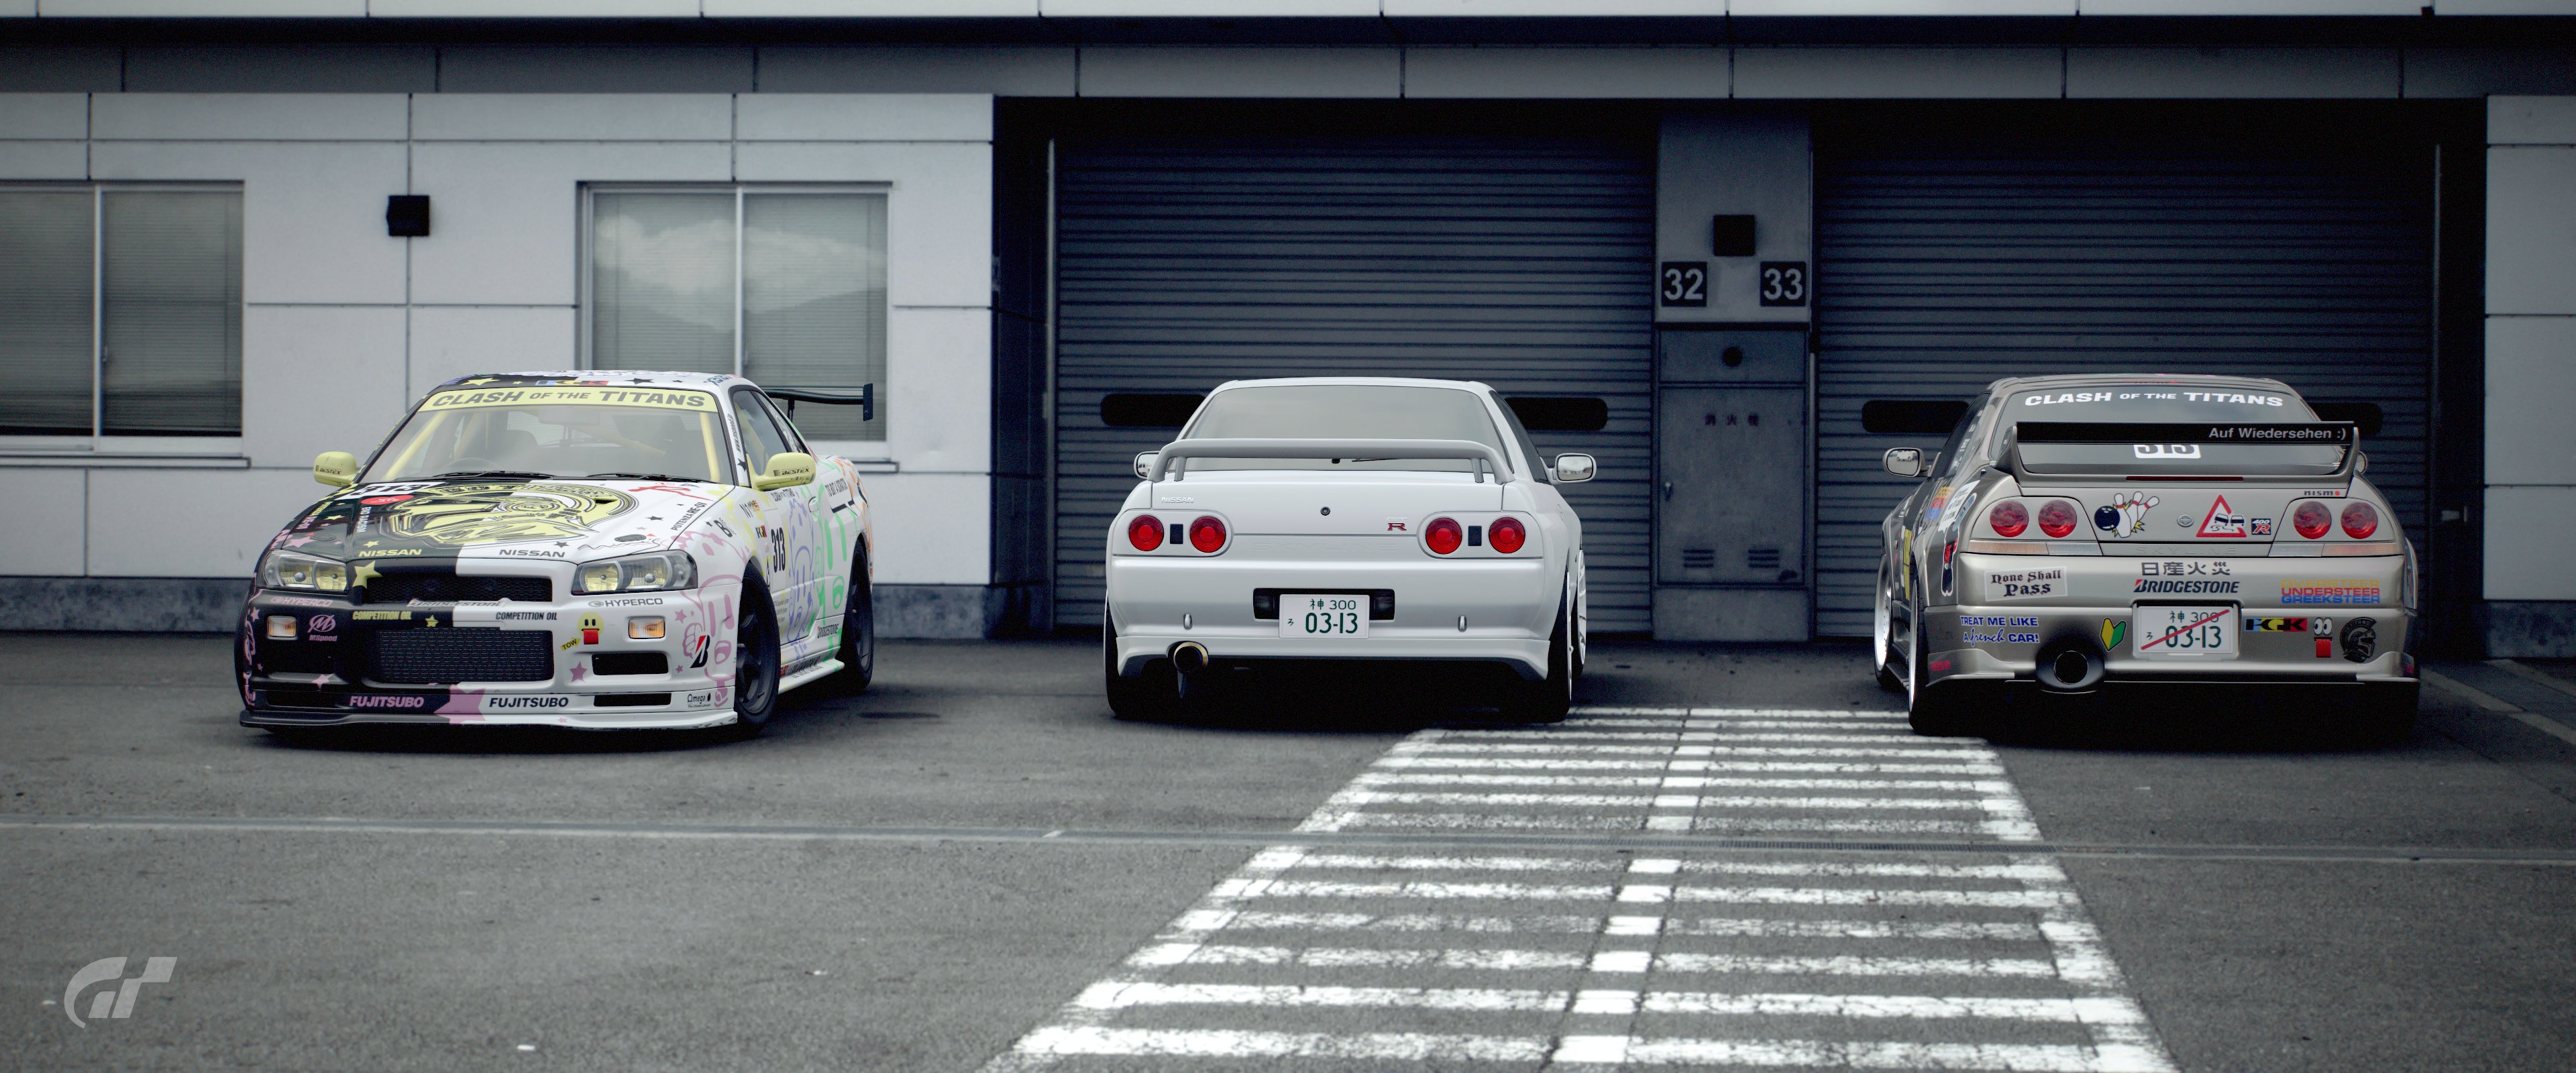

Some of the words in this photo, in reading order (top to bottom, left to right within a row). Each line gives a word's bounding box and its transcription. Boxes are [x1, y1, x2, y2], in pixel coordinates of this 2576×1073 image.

[1664, 268, 1703, 300] 32
[1763, 268, 1803, 300] 33
[433, 391, 524, 406] CLASH
[599, 391, 705, 407] TITANS
[2025, 392, 2112, 406] CLASH
[2183, 392, 2283, 406] TITANS
[2209, 427, 2233, 438] Auf
[2239, 427, 2331, 438] Wiedersehen
[671, 512, 694, 530] POTENZA
[690, 502, 707, 518] RE-01
[1387, 522, 1407, 530] R
[2253, 524, 2270, 534] R
[499, 549, 565, 557] NISSAN
[771, 527, 786, 573] 313
[1251, 543, 1397, 551] SKYLINE
[2141, 562, 2231, 575] 日産火災
[1991, 574, 2023, 584] None
[2027, 570, 2061, 582] Shall
[2282, 579, 2379, 587] OVERSTEER
[2004, 583, 2051, 597] Pass
[2133, 579, 2240, 594] BRIDGESTONE
[2282, 587, 2380, 596] UNDERSTEER
[282, 598, 333, 606] HYPERCO
[605, 598, 663, 607] HYPERCO
[1309, 599, 1324, 610] 神
[1330, 600, 1356, 610] 300
[2282, 596, 2379, 604] GREEKSTEER
[352, 611, 399, 620] COMPETITION
[400, 612, 412, 620] OIL
[495, 612, 544, 620] COMPETITION
[547, 612, 557, 620] OIL
[1960, 616, 1984, 625] TREAT
[1988, 617, 2005, 626] ME
[2010, 617, 2038, 626] LIKE
[2169, 610, 2185, 623] 神
[2190, 612, 2219, 622] 300
[1305, 612, 1358, 633] 03-13
[817, 624, 839, 639] BRIDGESTONE
[1964, 633, 1968, 641] A
[1969, 628, 2005, 647] french
[2008, 634, 2040, 643] CAR!
[2165, 625, 2222, 648] 03-13
[562, 638, 578, 651] TOW
[350, 695, 425, 708] FUJITSUBO
[489, 697, 569, 708] FUJITSUBO
